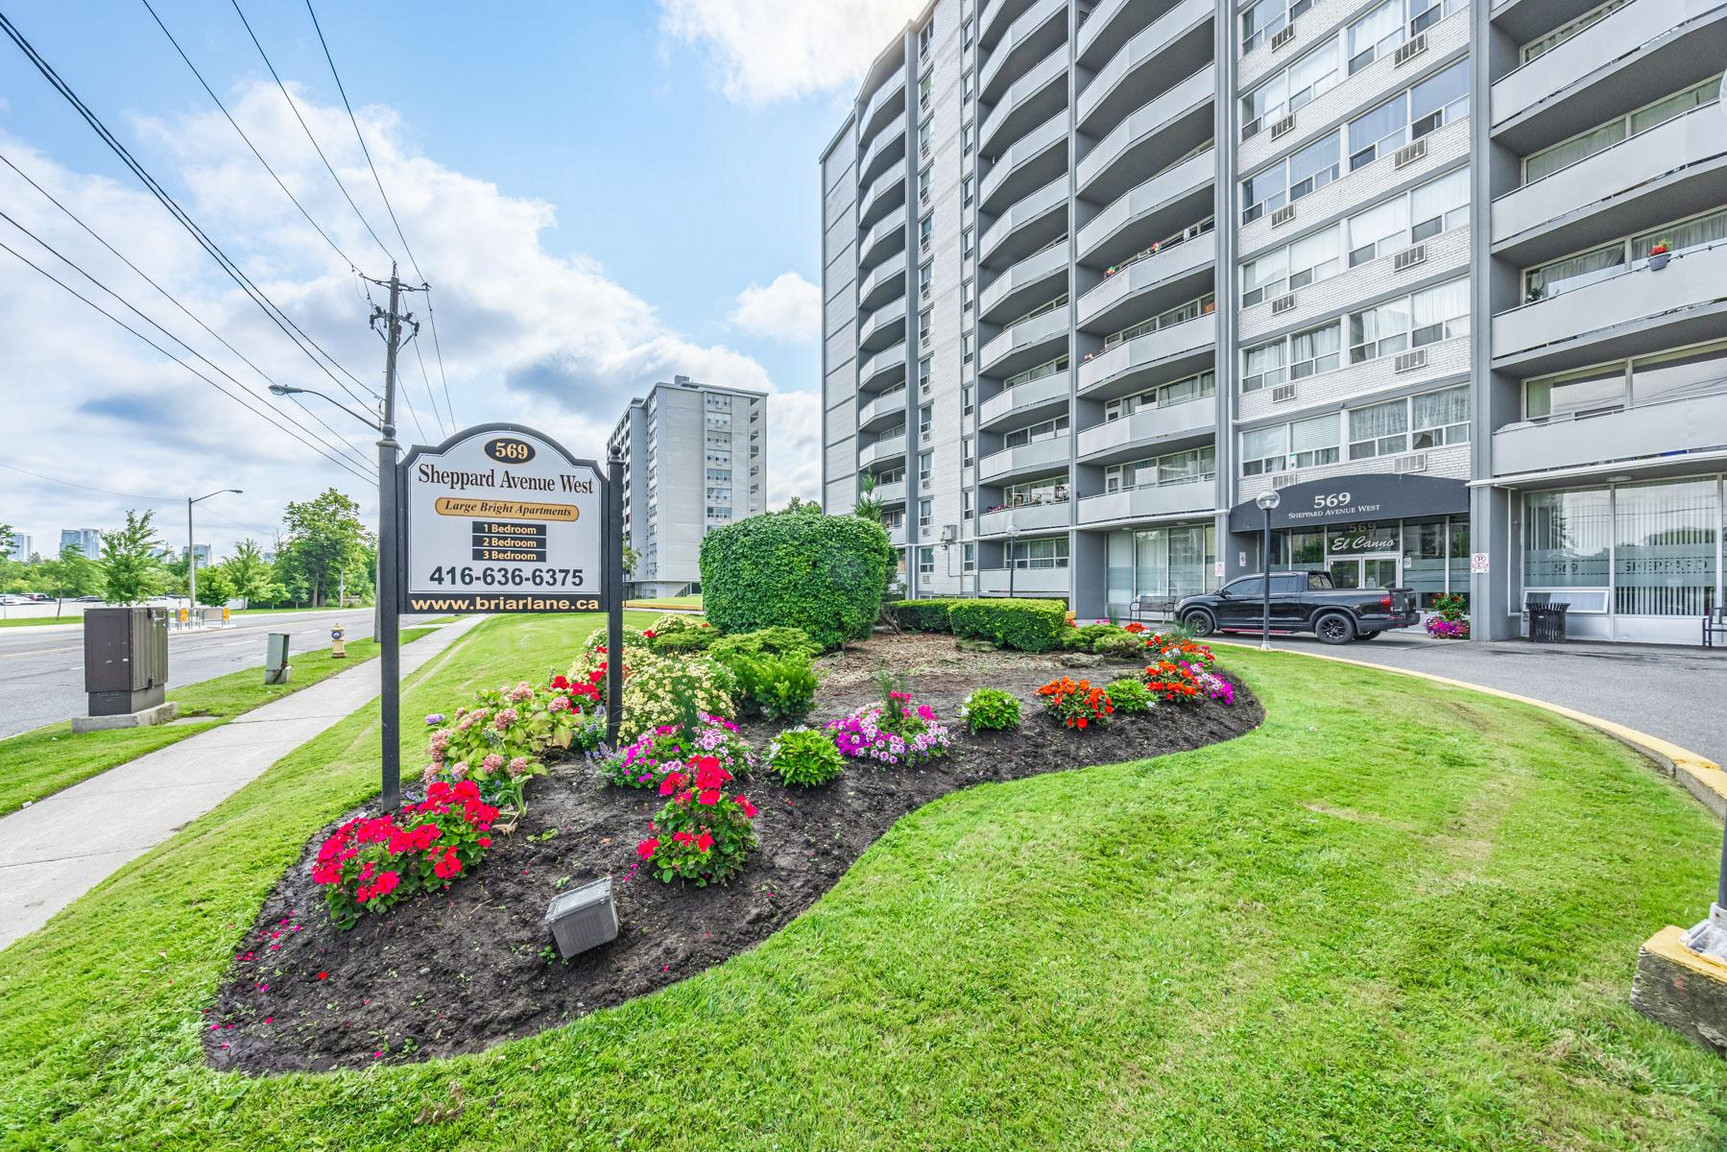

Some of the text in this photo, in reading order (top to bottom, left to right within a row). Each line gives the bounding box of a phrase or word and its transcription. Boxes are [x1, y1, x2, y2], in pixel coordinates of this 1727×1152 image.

[495, 442, 528, 459] 569
[418, 463, 594, 494] Sheppard Avenue West
[1314, 492, 1351, 508] 569
[445, 500, 572, 516] Large Bright Apartments
[1289, 511, 1323, 519] SHEPPARD
[1325, 507, 1355, 515] AVENUE
[484, 524, 536, 535] 1 Bedroom
[1348, 522, 1376, 532] 569
[483, 538, 536, 548] 2 Bedroom
[1332, 535, 1395, 550] El Canno
[483, 551, 536, 561] 3 Bedroom
[430, 566, 583, 586] 416-636-6375
[411, 597, 599, 610] www.briarlane.ca
